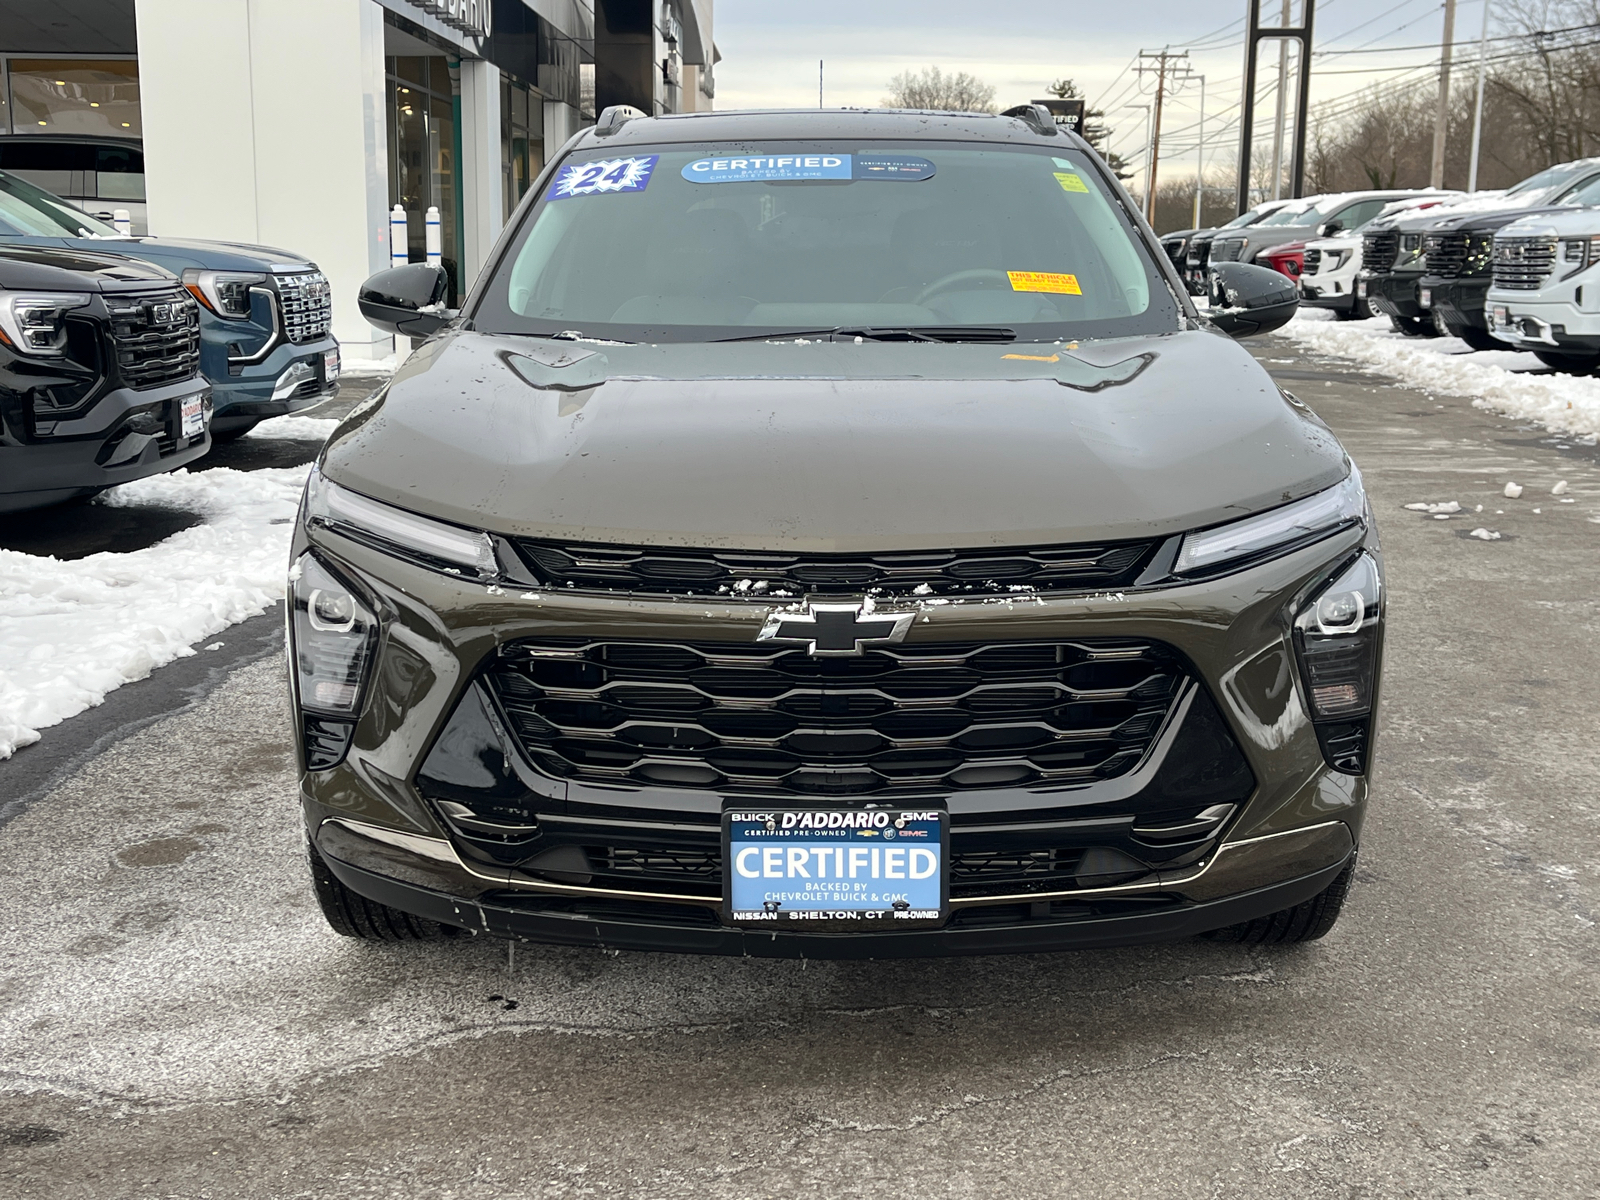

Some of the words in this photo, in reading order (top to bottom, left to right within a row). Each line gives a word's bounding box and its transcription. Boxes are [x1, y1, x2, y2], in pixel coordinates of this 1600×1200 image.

[691, 157, 842, 172] CERTIFIED
[573, 163, 631, 189] 24
[1033, 273, 1073, 281] VEHICLE
[731, 813, 775, 822] BUICK
[781, 812, 889, 829] D'ADDARIO
[900, 812, 939, 821] GMC
[735, 847, 938, 879] CERTIFIED
[805, 882, 850, 891] BACKED
[854, 882, 868, 891] BY
[764, 892, 829, 901] CHEVROLET
[833, 892, 868, 901] BUICK
[871, 893, 879, 902] &
[882, 893, 909, 902] GMC
[733, 911, 778, 921] NISSAN
[788, 911, 862, 921] SHELTON,
[865, 911, 885, 920] CT
[893, 910, 939, 920] PRE-OWNED
